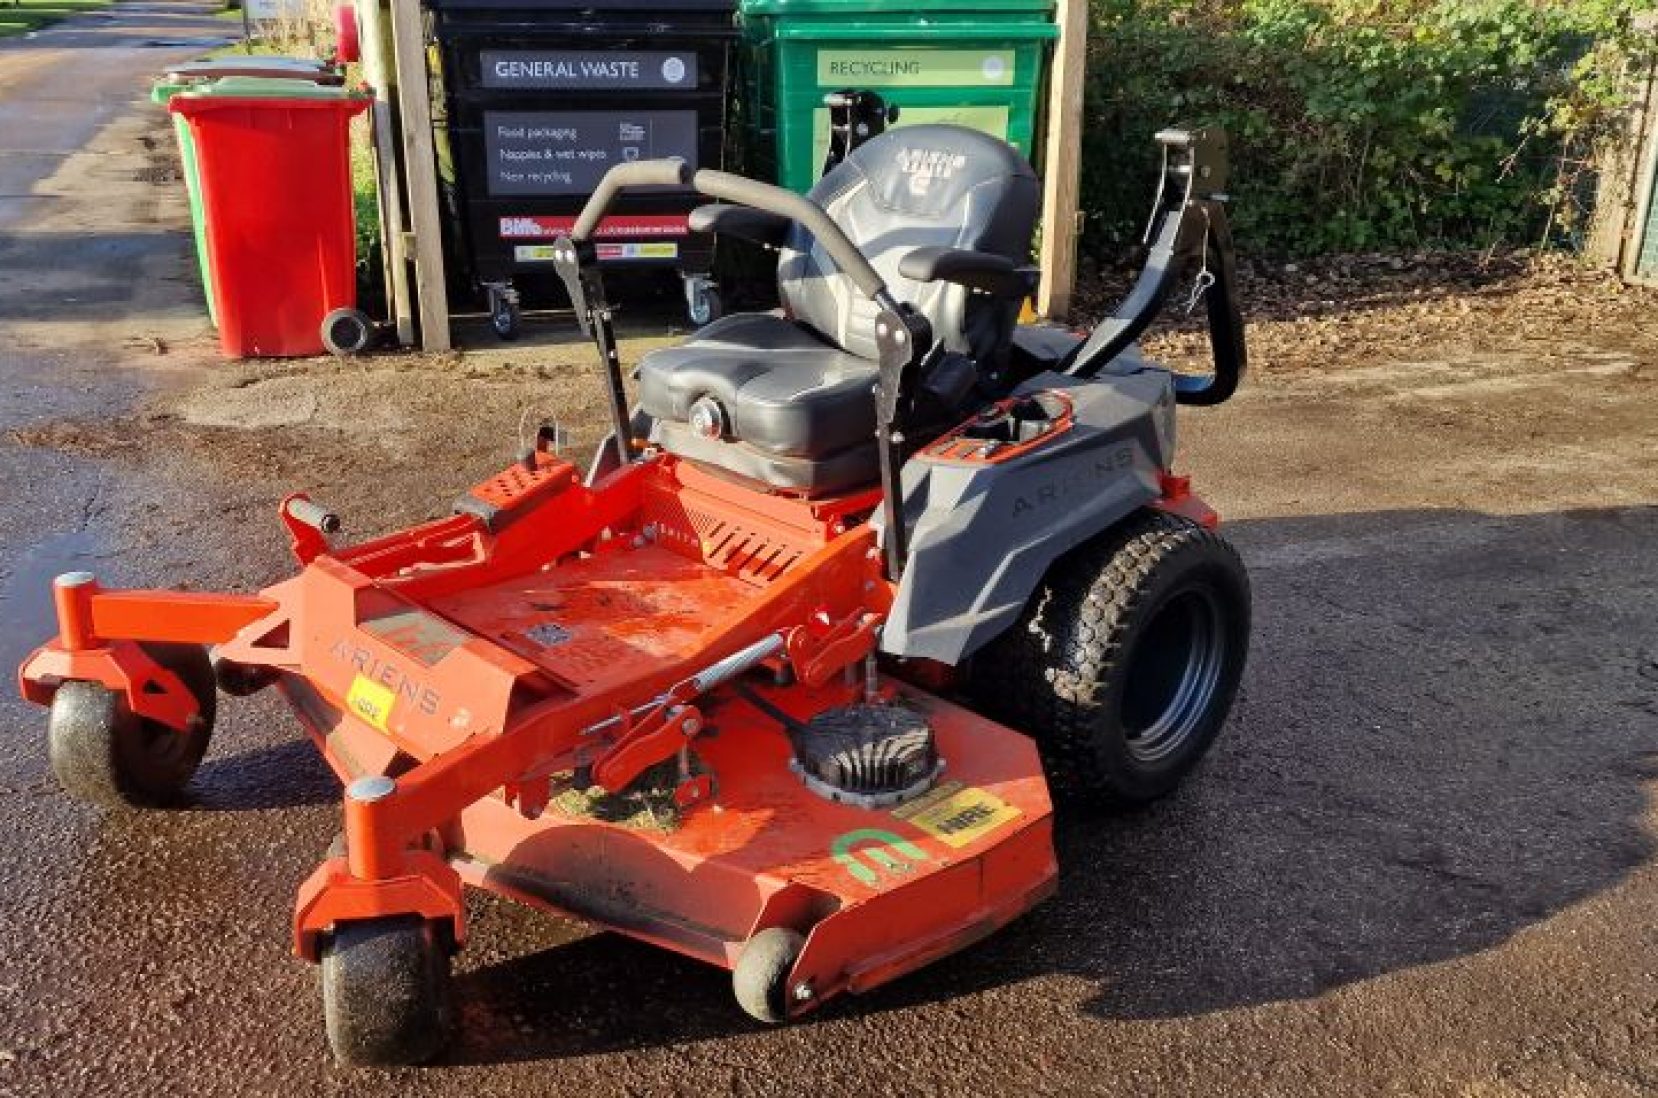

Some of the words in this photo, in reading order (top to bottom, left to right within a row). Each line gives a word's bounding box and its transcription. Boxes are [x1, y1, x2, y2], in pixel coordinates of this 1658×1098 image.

[495, 60, 577, 78] GENERAL
[580, 60, 640, 79] WASTE
[829, 60, 920, 76] RECYCLING
[498, 125, 525, 138] Food
[528, 126, 578, 142] packaging
[527, 170, 573, 185] recycling
[1012, 446, 1135, 519] ARINS
[329, 640, 441, 716] ARIENS
